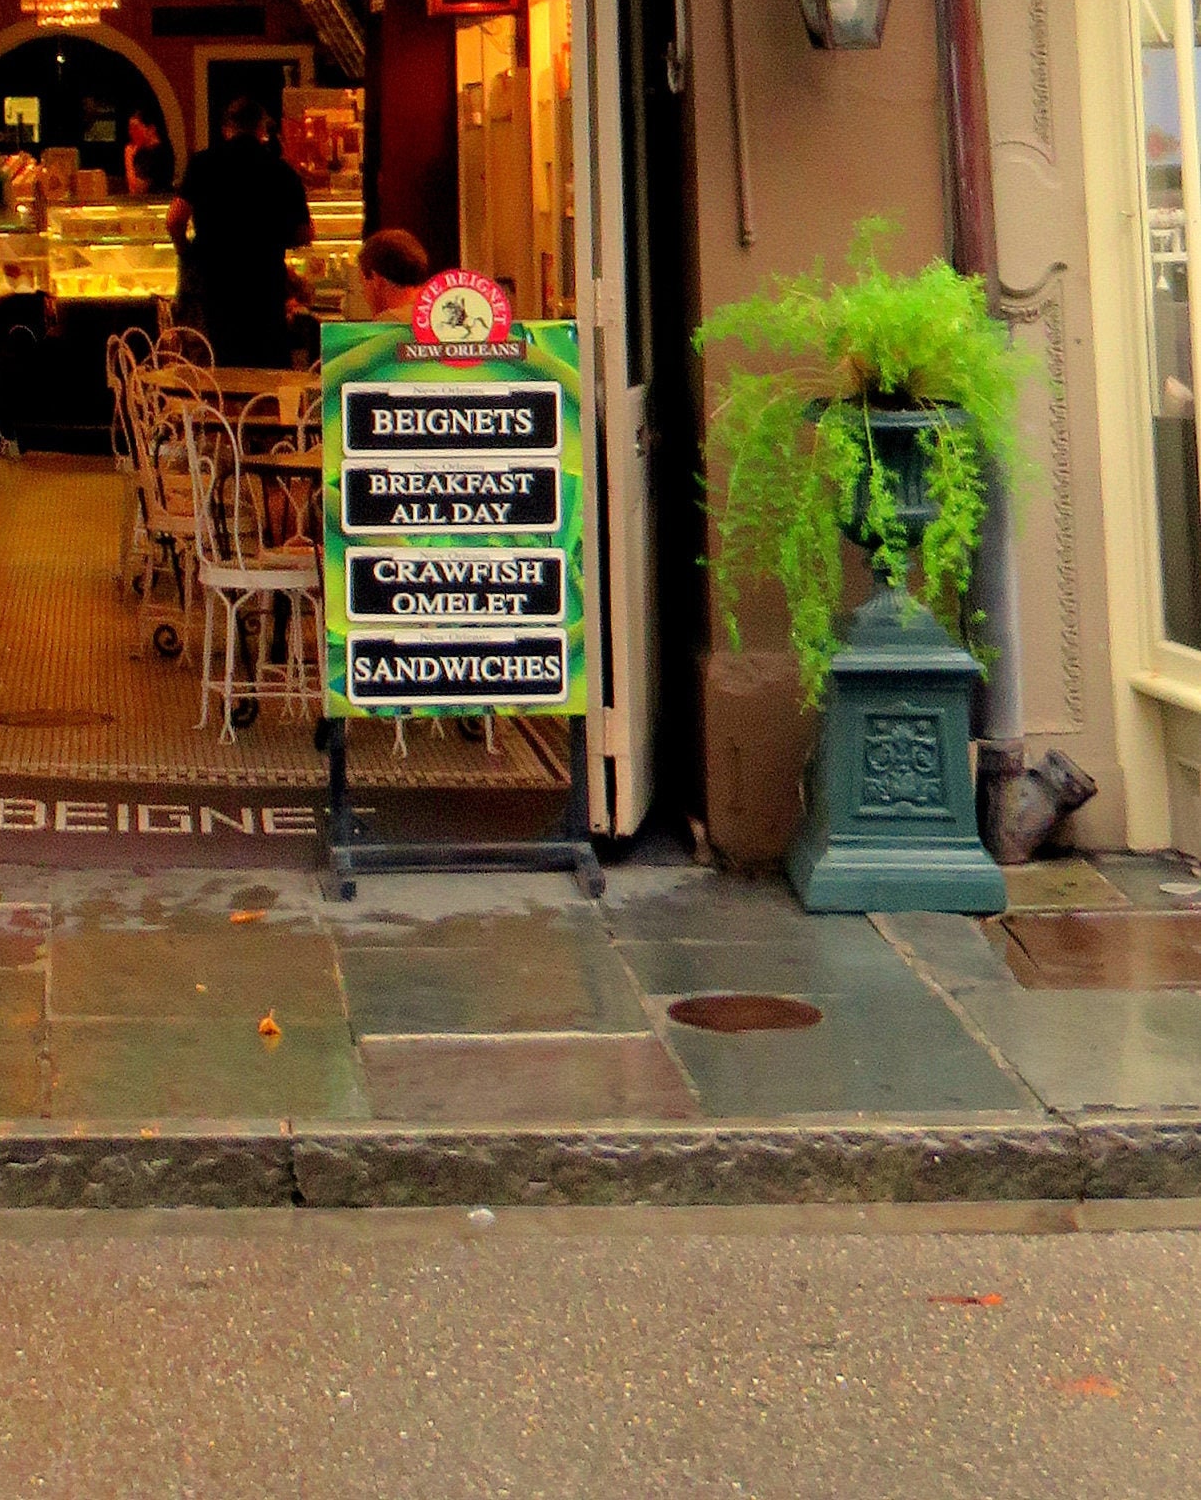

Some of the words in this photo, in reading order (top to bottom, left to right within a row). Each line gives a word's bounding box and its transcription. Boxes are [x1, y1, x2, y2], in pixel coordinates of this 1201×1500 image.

[416, 281, 443, 329] CAFE
[445, 272, 507, 326] BEIGNET
[405, 346, 443, 357] NEW
[446, 343, 520, 357] ORLEANS
[371, 408, 533, 435] BEIGNETS
[369, 473, 534, 494] BREAKFAST
[390, 503, 445, 524] ALL
[452, 503, 511, 524] DAY
[373, 560, 543, 583] CRAWFISH
[392, 592, 528, 614] OMELET
[354, 655, 561, 682] SANDWICHES
